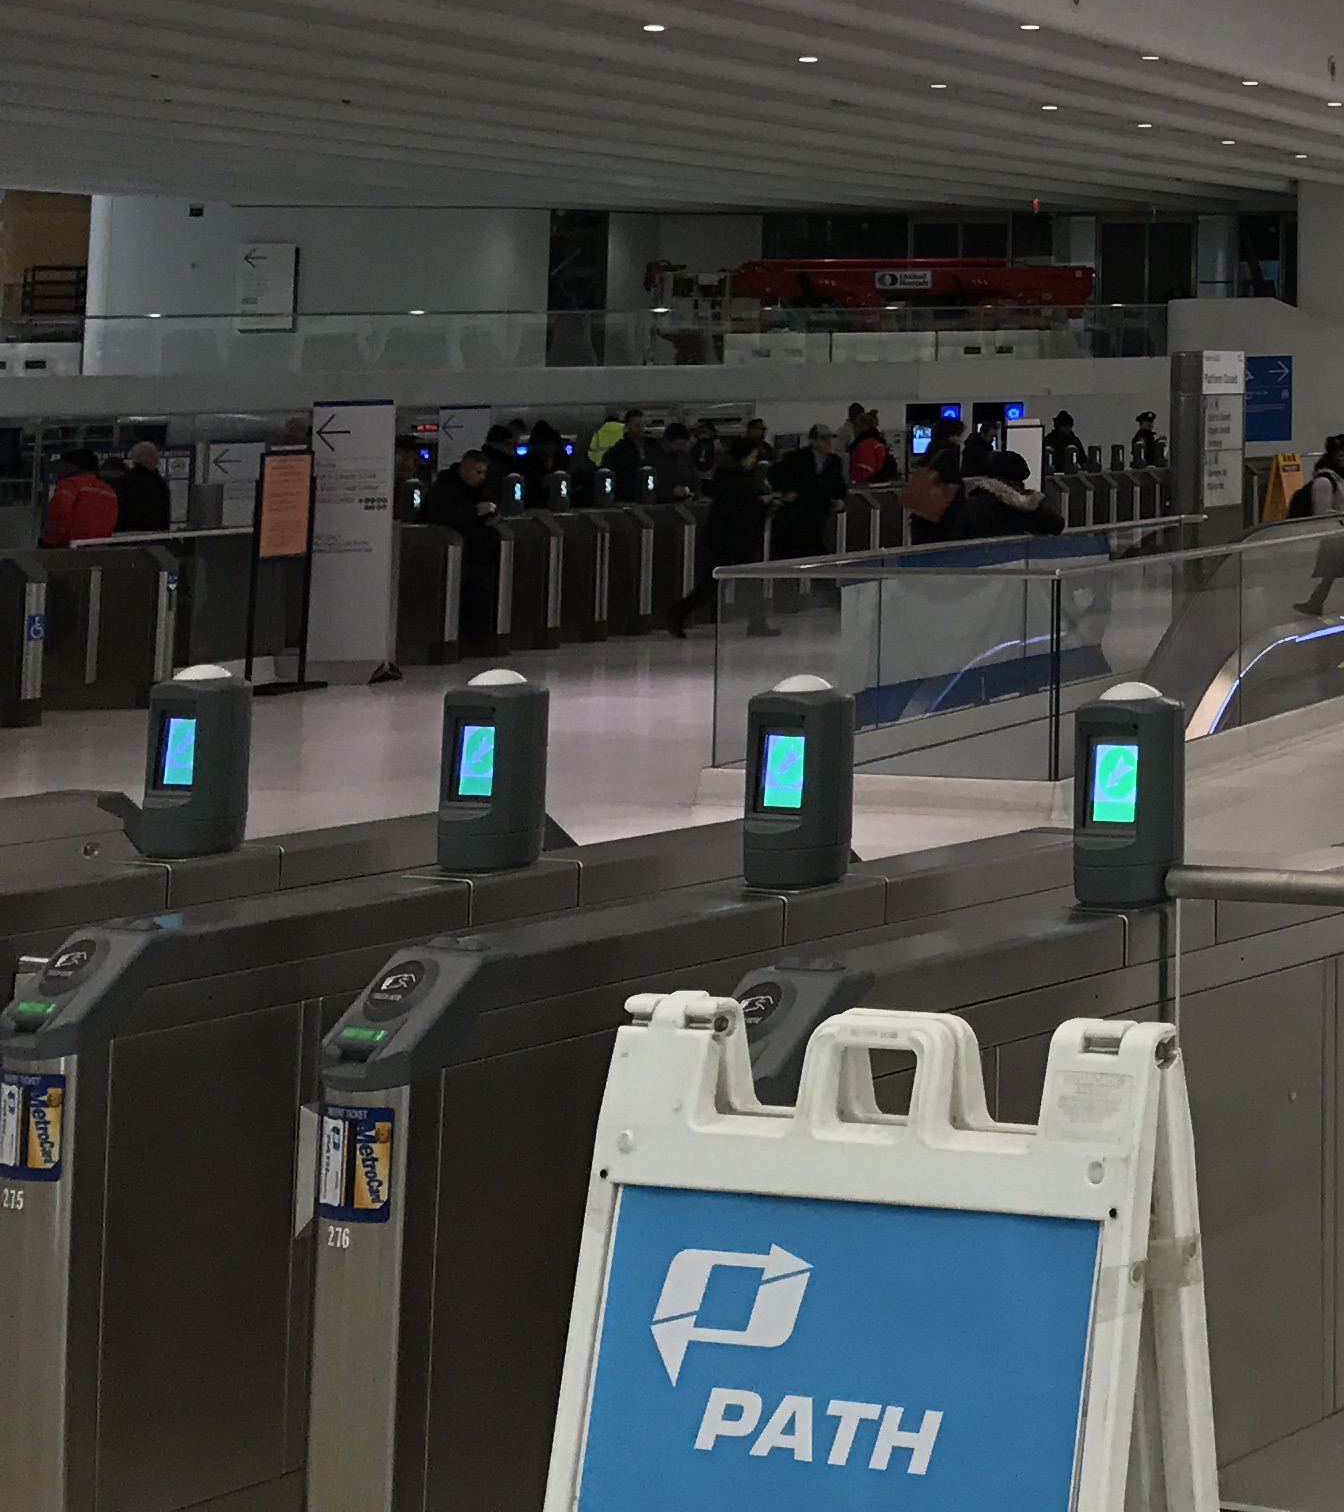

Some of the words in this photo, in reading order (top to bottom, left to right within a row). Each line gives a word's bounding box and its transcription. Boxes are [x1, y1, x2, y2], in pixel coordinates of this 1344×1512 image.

[899, 272, 927, 280] United
[899, 279, 929, 287] Rentals
[31, 1088, 57, 1165] MetroCard
[356, 1121, 385, 1205] MetroCard
[2, 1188, 24, 1211] 275
[327, 1225, 351, 1249] 276
[694, 1387, 944, 1475] PATH
